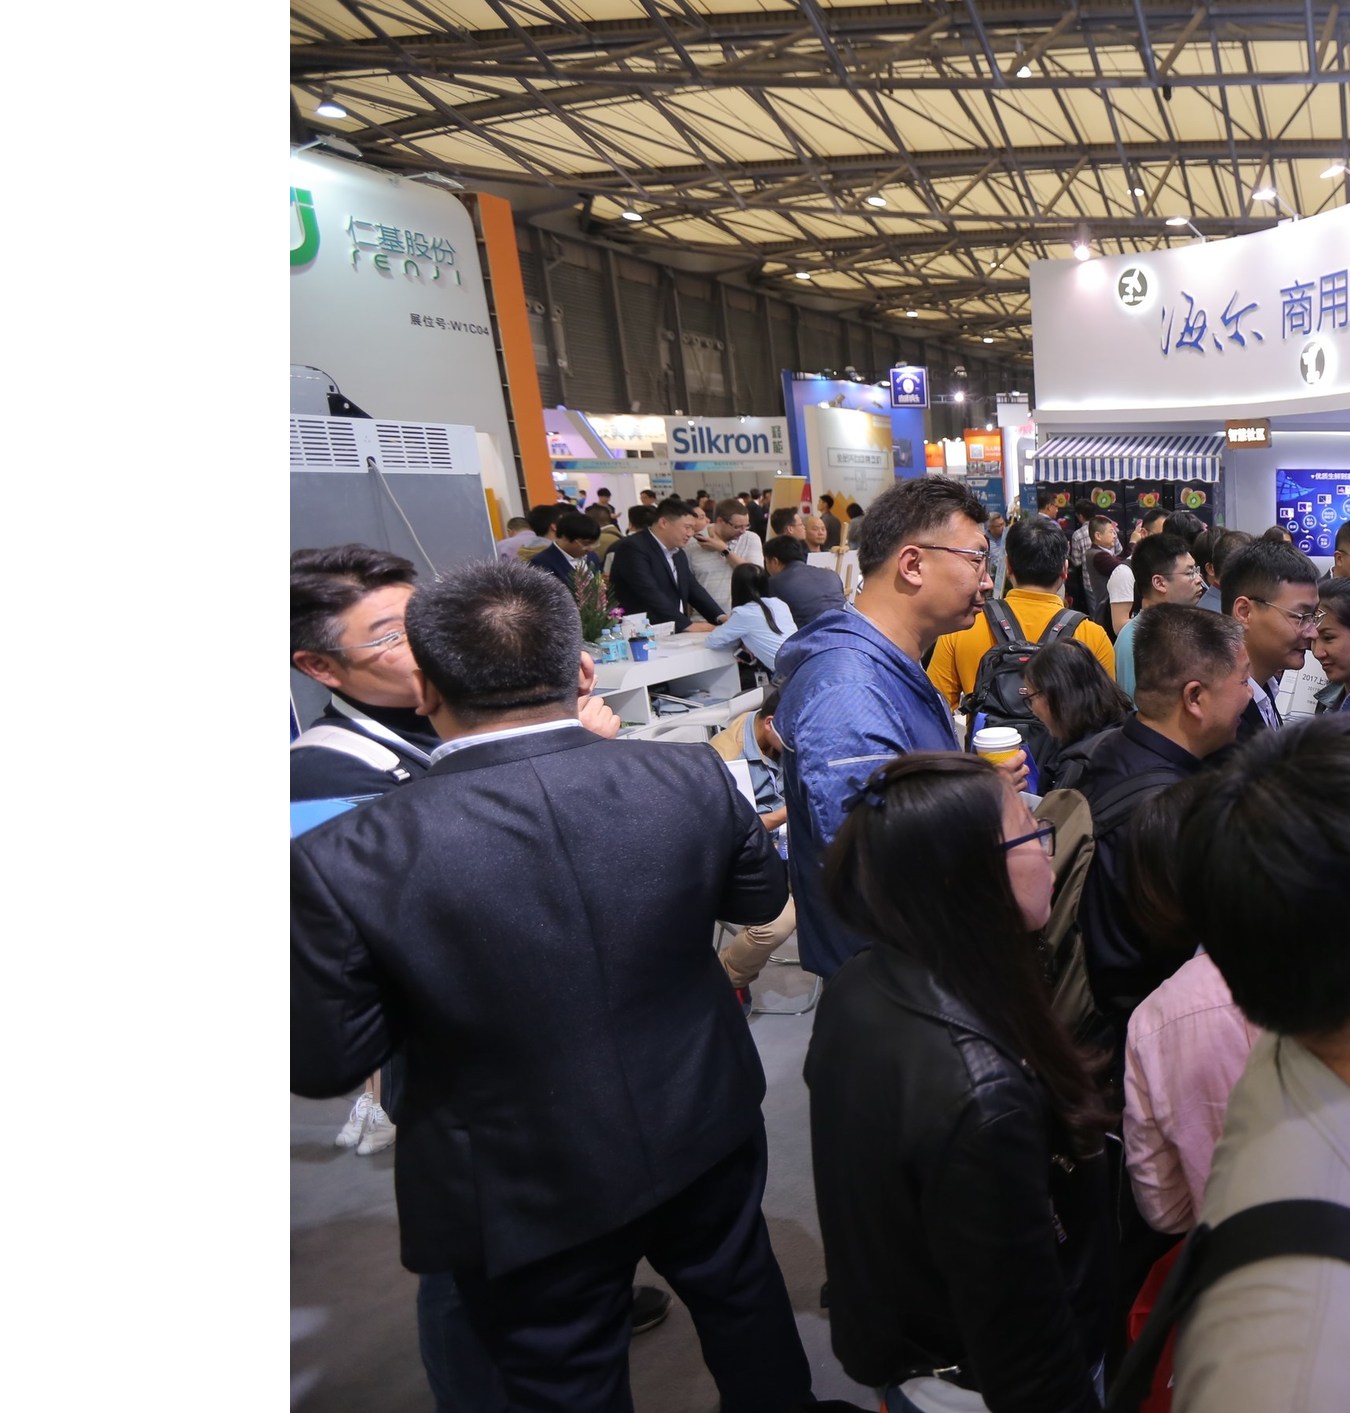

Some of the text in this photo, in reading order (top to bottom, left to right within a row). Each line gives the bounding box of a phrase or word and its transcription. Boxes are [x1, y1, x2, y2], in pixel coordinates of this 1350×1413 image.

[346, 215, 456, 266] 仁基股份
[410, 312, 490, 336] 展位号:W1C04
[672, 426, 769, 454] Silkron
